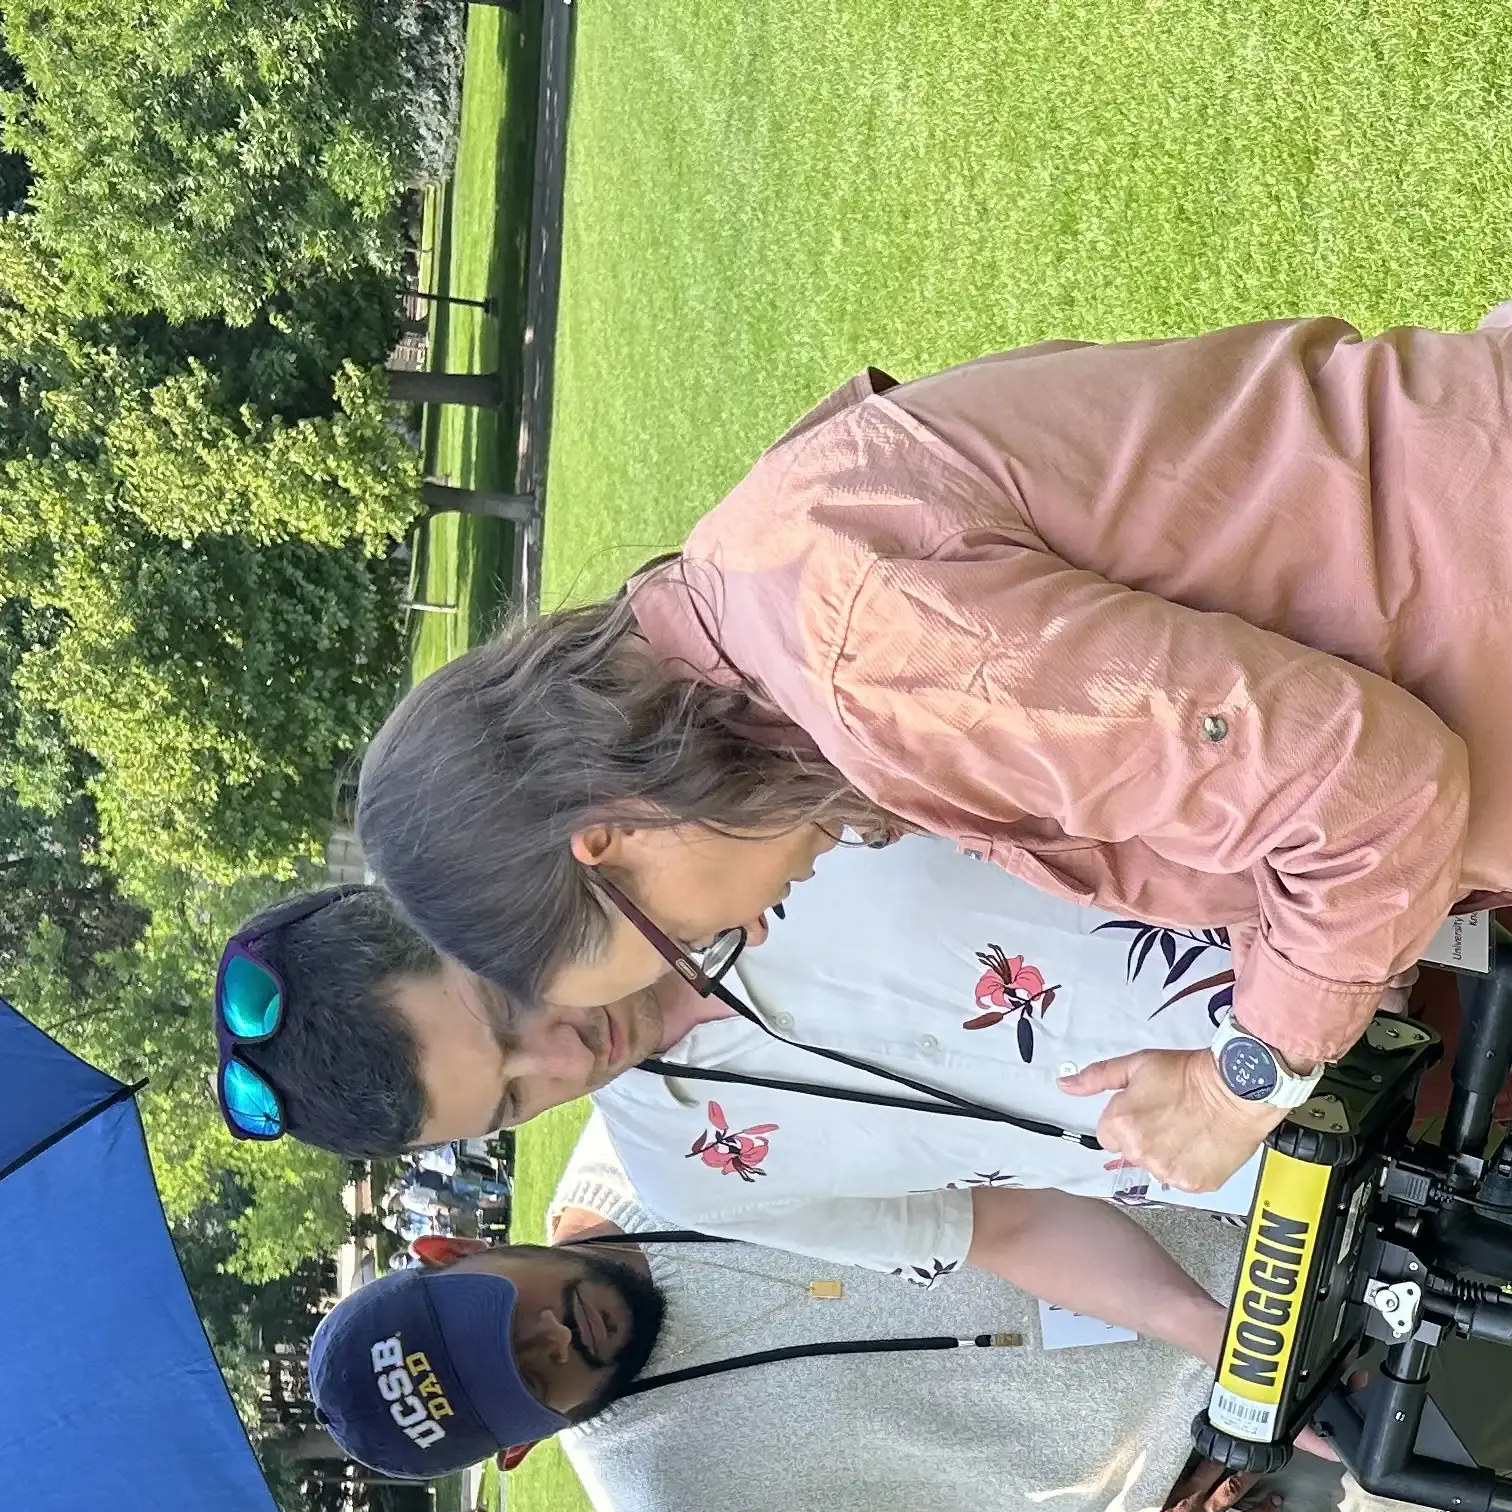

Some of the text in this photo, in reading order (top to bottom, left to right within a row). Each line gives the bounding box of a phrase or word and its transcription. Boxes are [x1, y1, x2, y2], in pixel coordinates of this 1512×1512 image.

[1453, 916, 1464, 960] University
[1228, 1208, 1310, 1387] NOGGIN
[371, 1336, 446, 1449] UCSB
[406, 1351, 454, 1420] DAD
